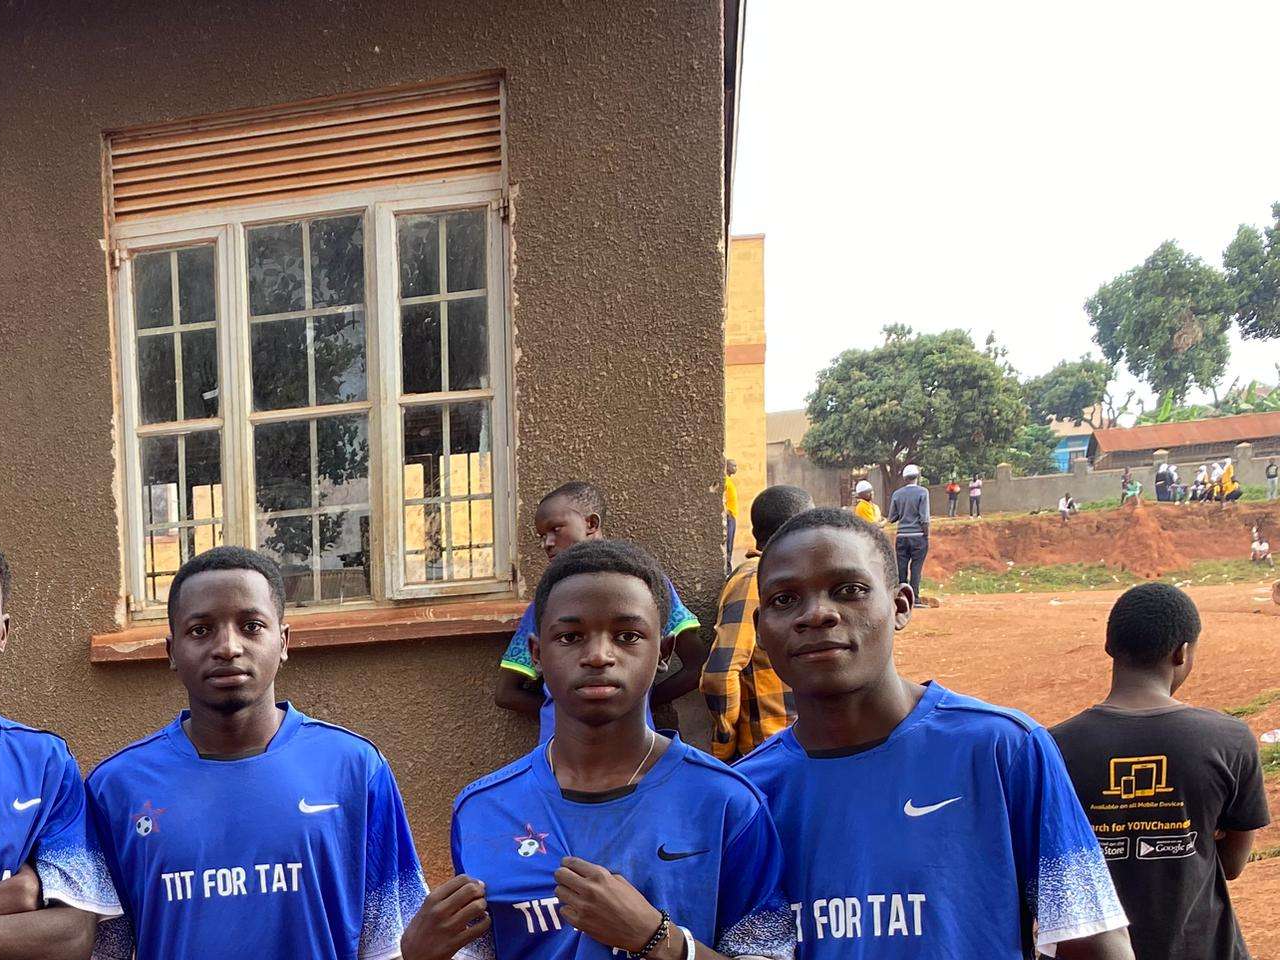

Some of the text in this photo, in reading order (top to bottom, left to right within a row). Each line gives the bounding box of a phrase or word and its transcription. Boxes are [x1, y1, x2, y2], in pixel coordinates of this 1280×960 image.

[1111, 823, 1125, 832] for
[1155, 844, 1185, 854] Google
[161, 863, 302, 901] TIT FOR TAT
[513, 897, 562, 934] TIT
[813, 897, 862, 939] FOR
[867, 894, 926, 937] TAT
